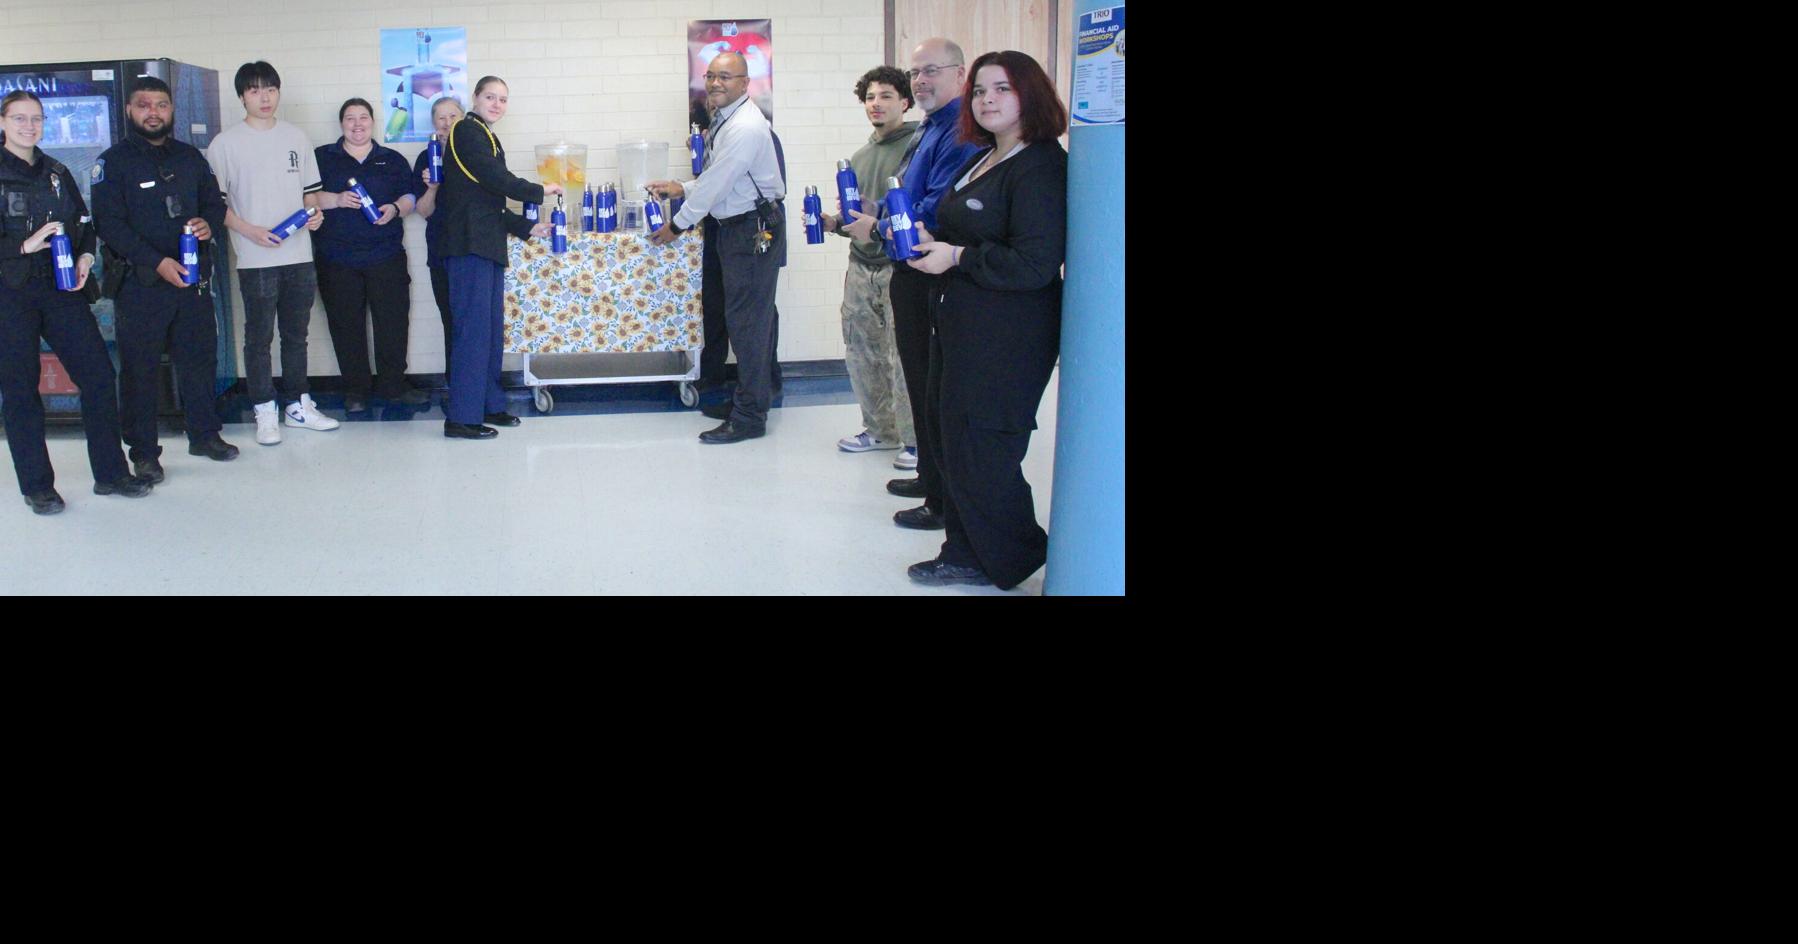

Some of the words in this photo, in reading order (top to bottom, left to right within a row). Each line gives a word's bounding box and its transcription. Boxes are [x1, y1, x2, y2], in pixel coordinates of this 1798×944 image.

[1094, 9, 1110, 19] TRIO
[1107, 24, 1119, 32] AID
[0, 75, 57, 93] ASANI
